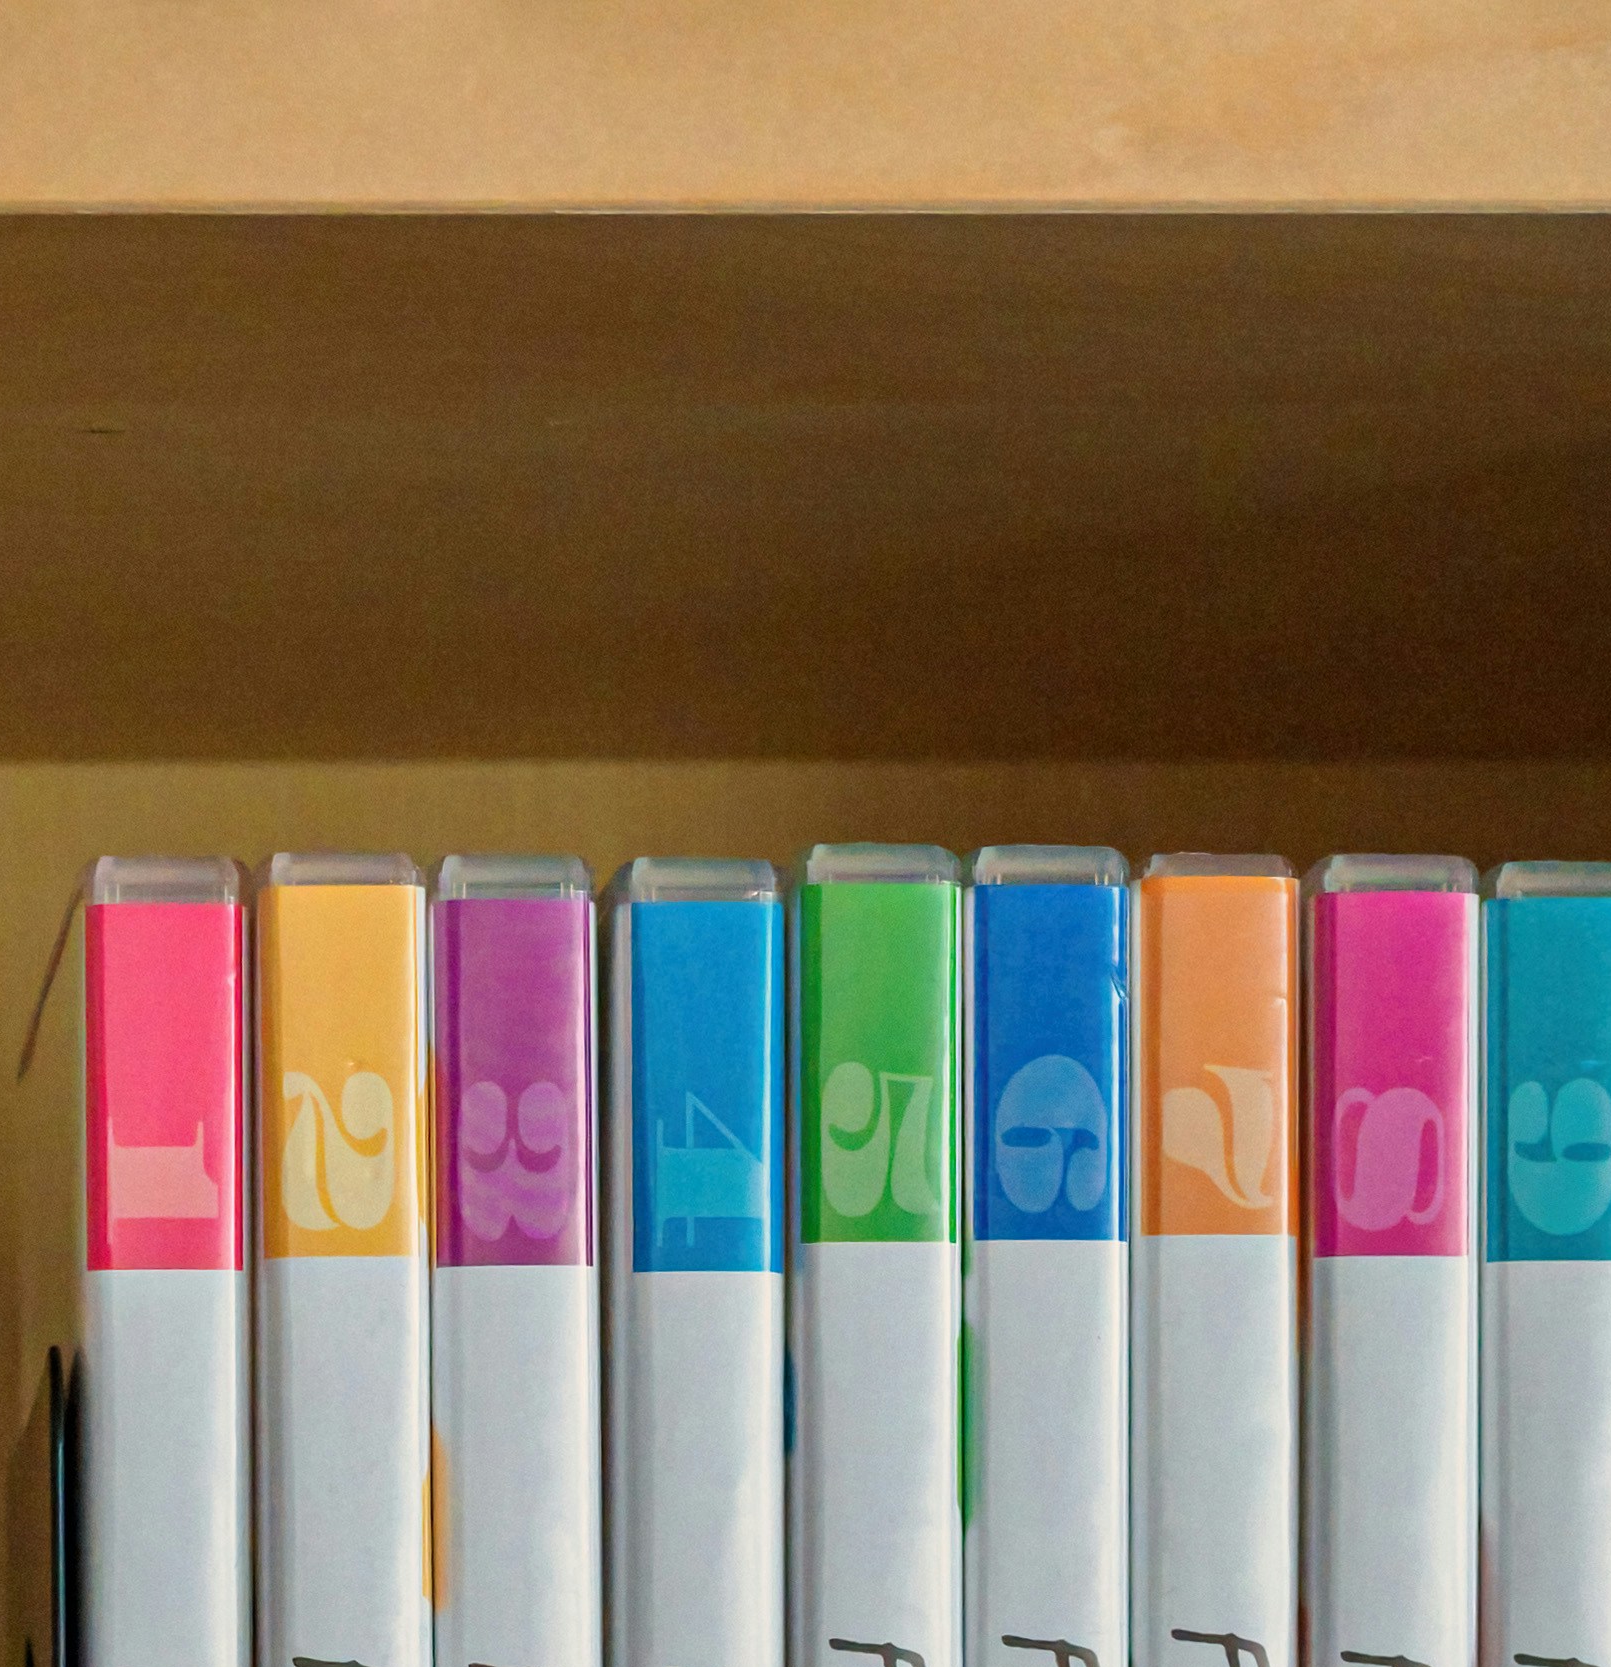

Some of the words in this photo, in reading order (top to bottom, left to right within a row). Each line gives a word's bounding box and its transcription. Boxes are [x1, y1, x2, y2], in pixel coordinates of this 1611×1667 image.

[108, 1117, 219, 1245] 1
[281, 1071, 393, 1230] 2
[460, 1080, 568, 1242] 3
[656, 1091, 768, 1248] 4
[820, 1061, 940, 1217] 5
[996, 1054, 1107, 1213] 6
[1162, 1064, 1272, 1210] 7
[1335, 1087, 1443, 1231] 8
